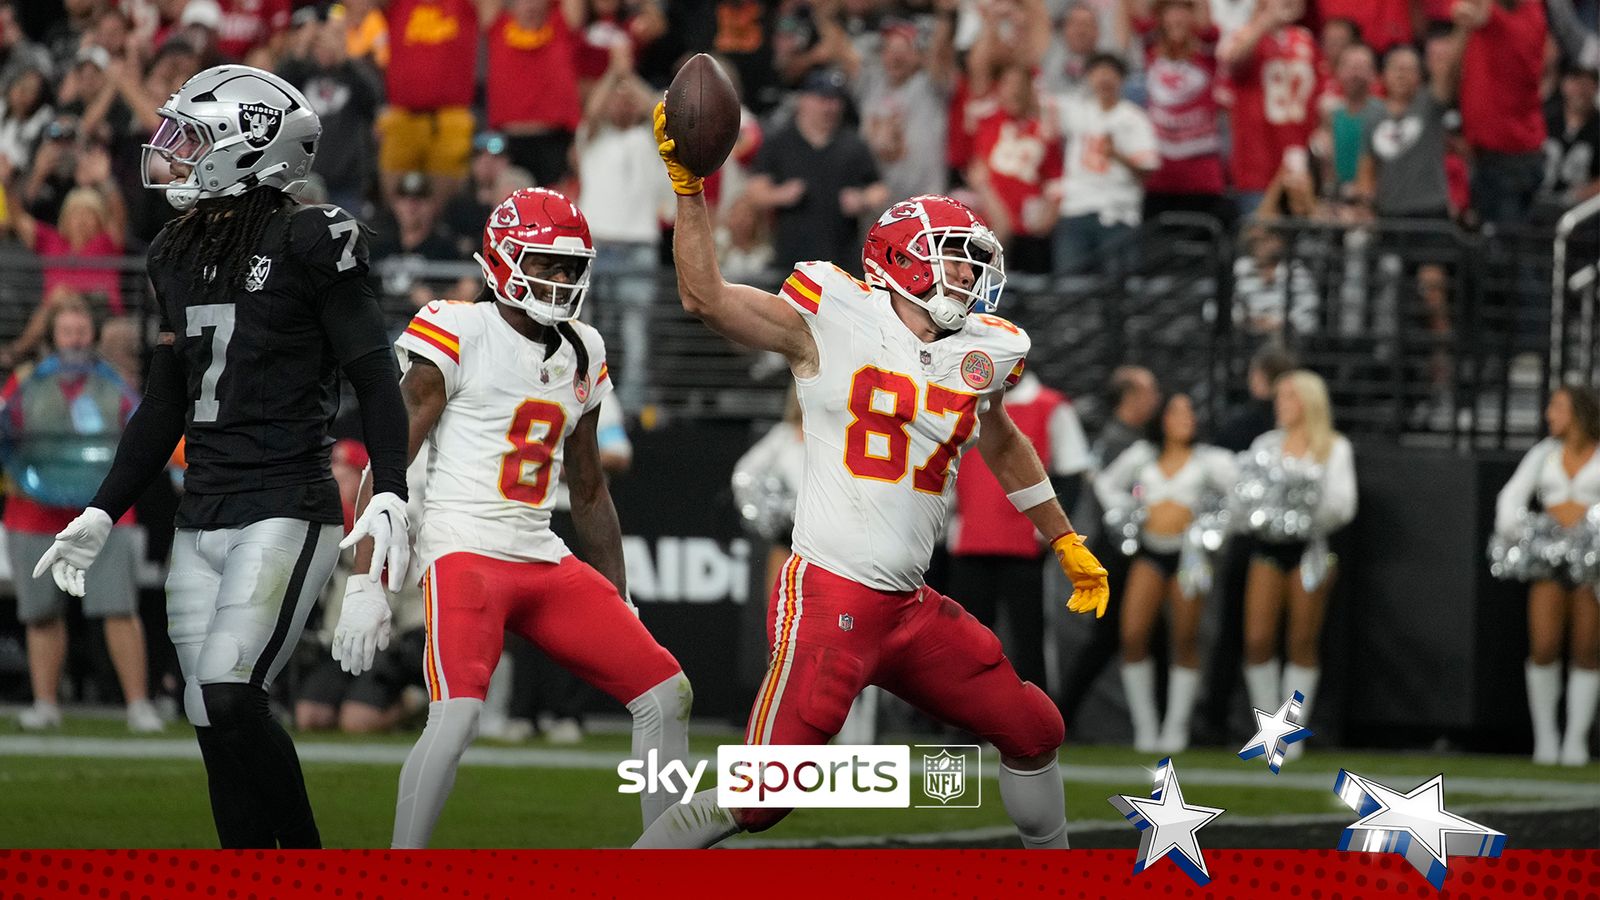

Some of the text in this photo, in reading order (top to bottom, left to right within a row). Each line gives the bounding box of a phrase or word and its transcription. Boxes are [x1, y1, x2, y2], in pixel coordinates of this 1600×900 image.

[242, 104, 279, 116] RAIDERS
[328, 219, 359, 272] 7
[185, 303, 236, 422] 7
[497, 397, 568, 508] 8
[843, 364, 979, 496] 87
